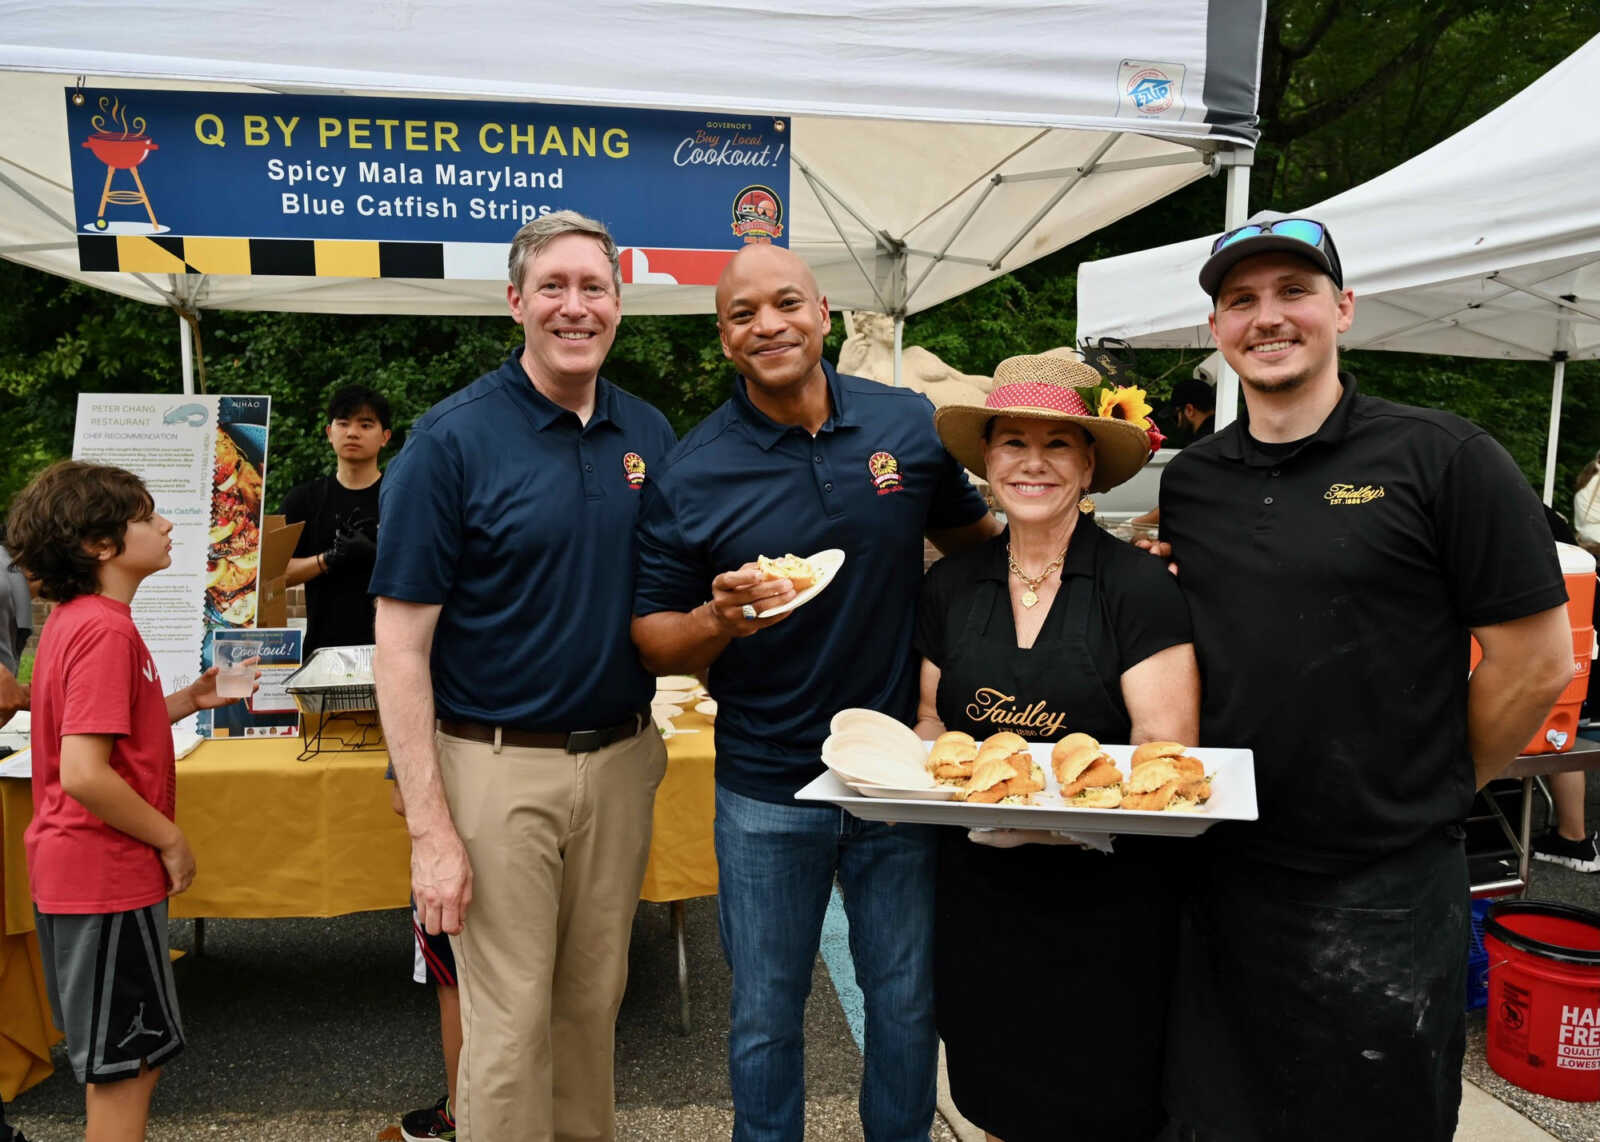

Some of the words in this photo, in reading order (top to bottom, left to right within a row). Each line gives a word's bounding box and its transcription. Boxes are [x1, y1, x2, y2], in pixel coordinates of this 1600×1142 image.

[194, 113, 226, 147] Q
[243, 115, 300, 147] BY
[318, 117, 461, 153] PETER
[479, 122, 630, 159] CHANG
[706, 121, 752, 130] GOVERNOR'S
[695, 129, 721, 148] Buy
[732, 132, 763, 146] Local
[673, 137, 785, 167] Cookout!
[267, 158, 347, 188] Spicy
[358, 161, 423, 185] Mala
[435, 163, 563, 192] Maryland
[281, 192, 345, 216] Blue
[356, 194, 457, 218] Catfish
[469, 198, 552, 225] Strips
[91, 404, 120, 413] PETER
[122, 404, 156, 413] CHANG
[90, 418, 150, 426] RESTAURANT
[231, 642, 295, 658] Cookout!
[966, 687, 1068, 737] Faidley
[1561, 1005, 1600, 1027] HA
